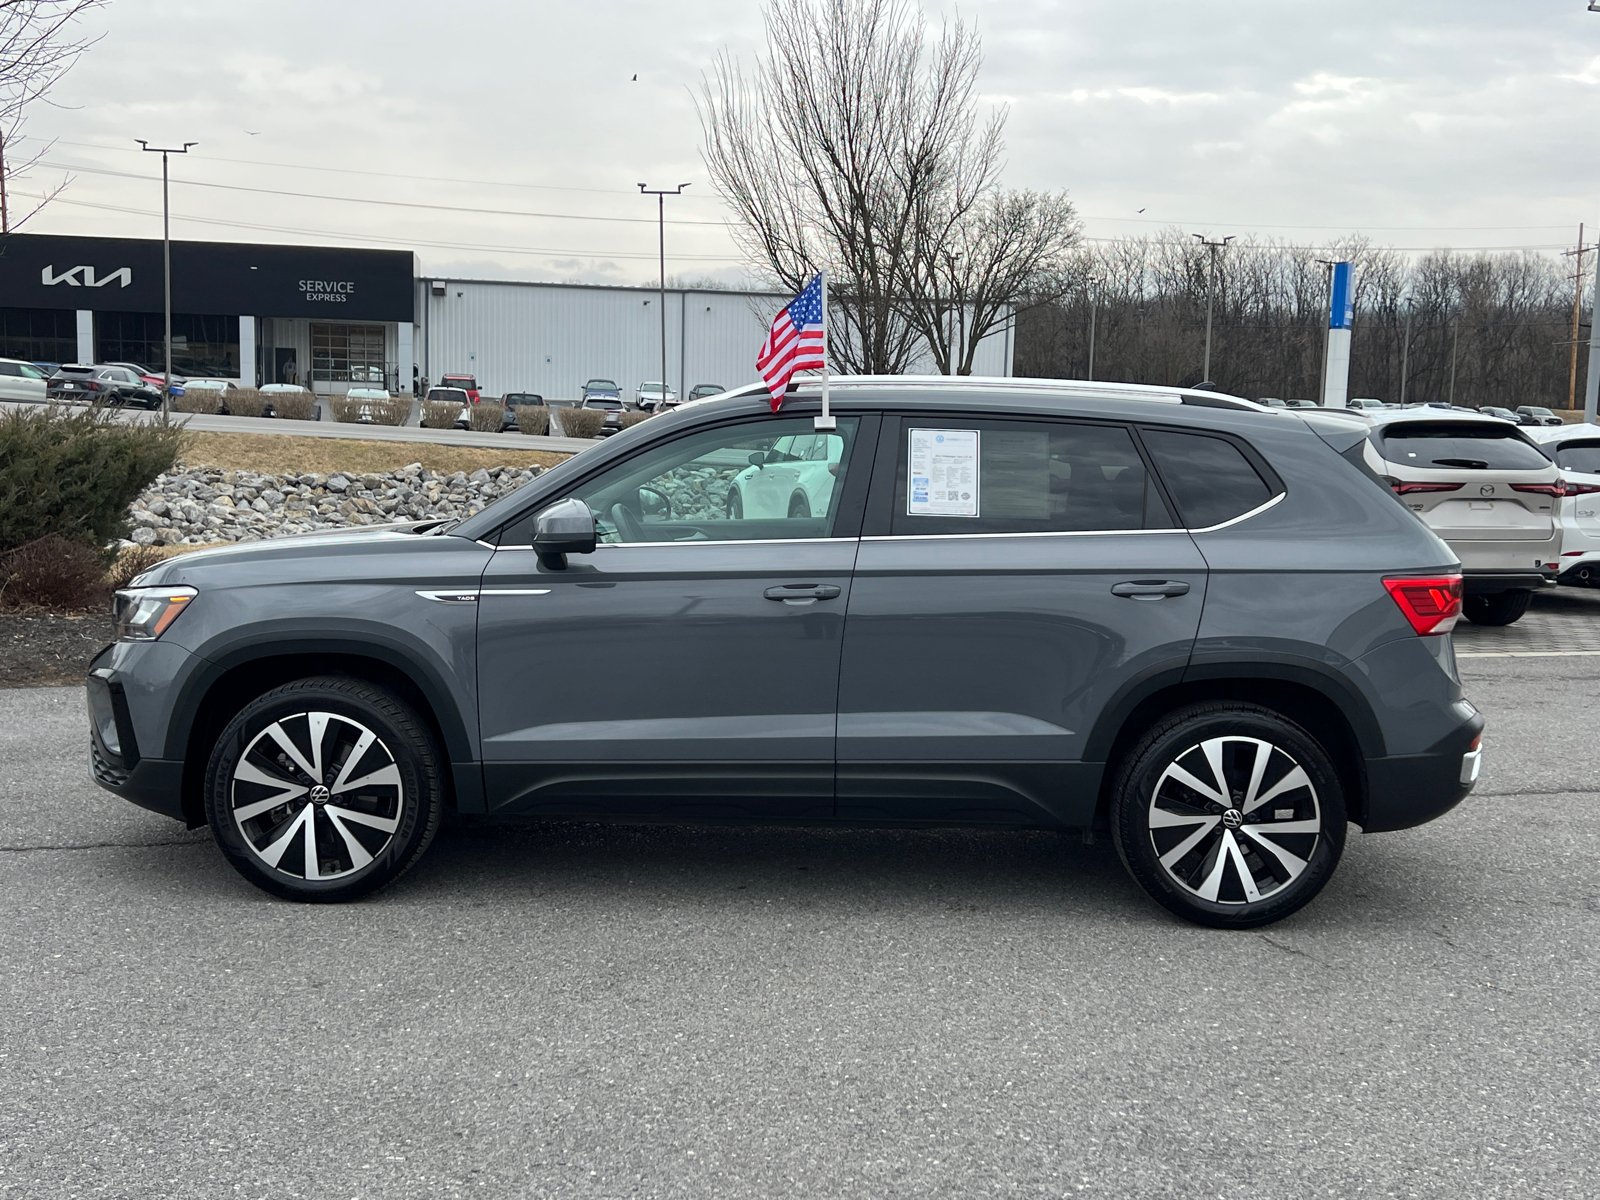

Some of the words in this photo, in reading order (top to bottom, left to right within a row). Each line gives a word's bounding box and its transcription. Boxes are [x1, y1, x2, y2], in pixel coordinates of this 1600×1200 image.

[42, 264, 132, 288] KIA
[298, 279, 355, 293] SERVICE
[306, 293, 347, 302] EXPRESS
[218, 754, 232, 832] ASSURANCE
[402, 760, 419, 840] GOODYEAR
